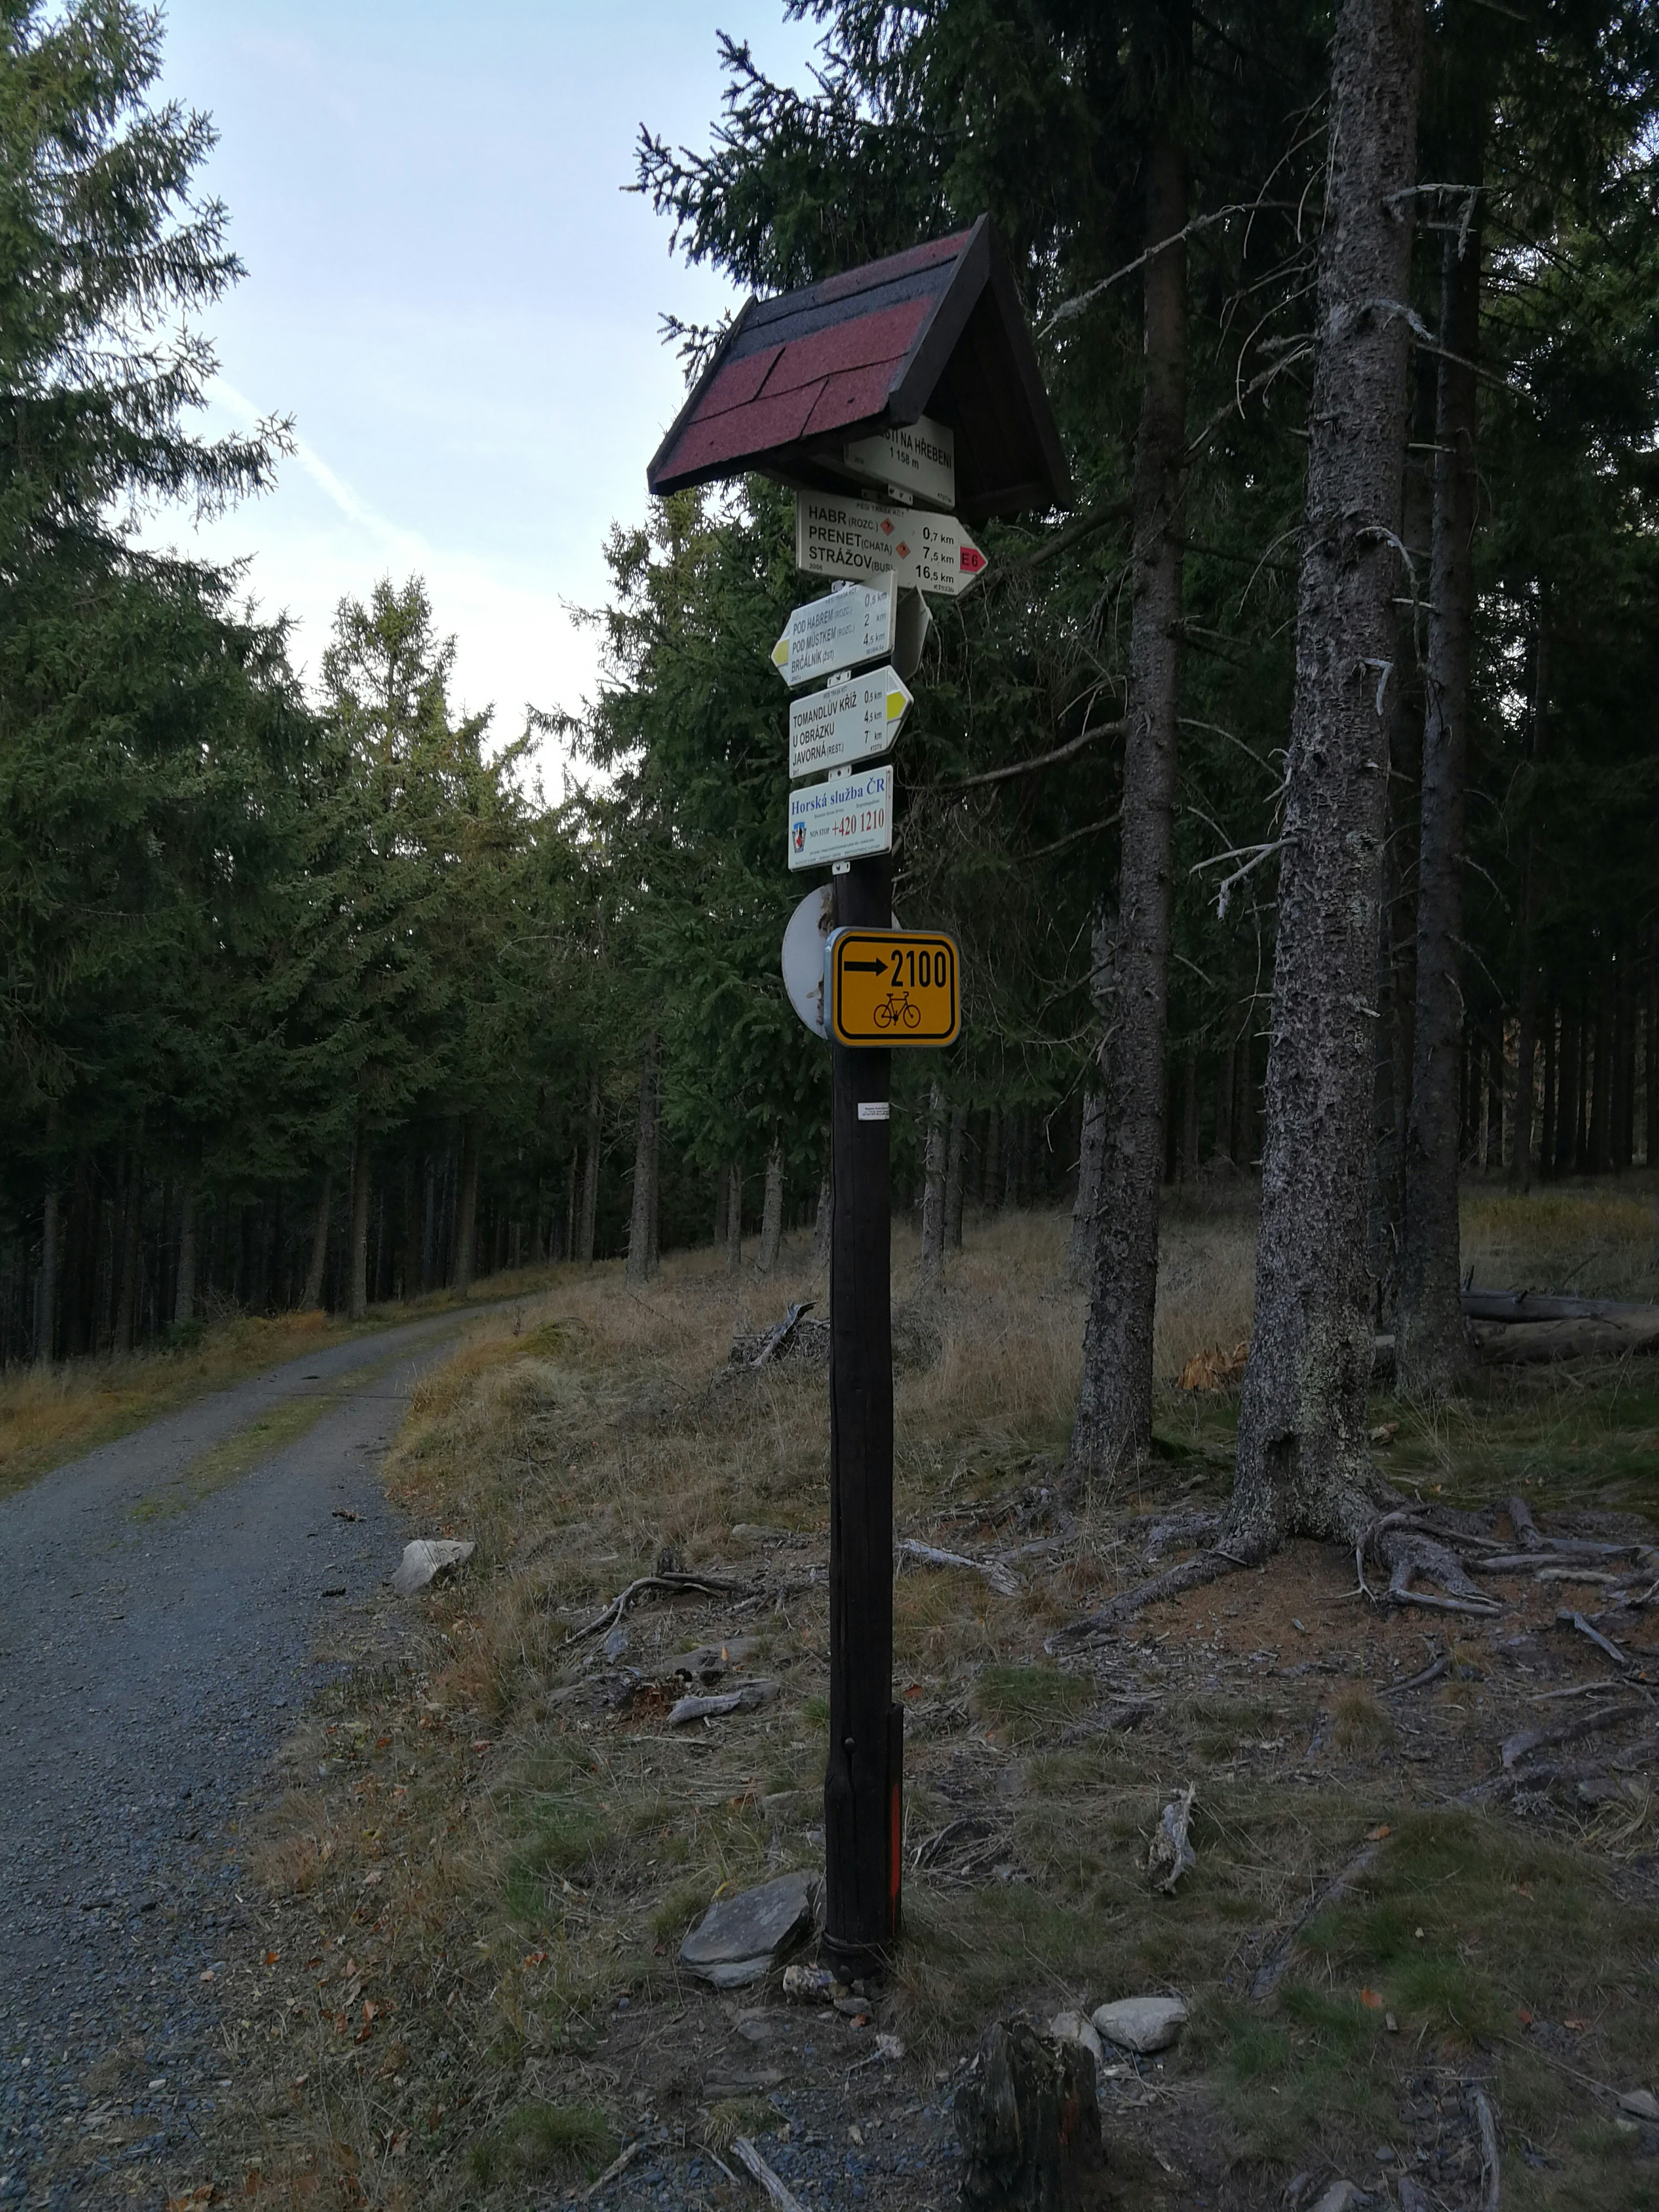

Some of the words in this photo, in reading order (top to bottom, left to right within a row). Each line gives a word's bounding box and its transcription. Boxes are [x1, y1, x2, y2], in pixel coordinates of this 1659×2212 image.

[901, 431, 913, 451] NA
[915, 438, 951, 469] HŘEBENI
[912, 458, 919, 470] m
[809, 505, 846, 524] HABR
[923, 527, 938, 543] 0,7
[941, 534, 954, 545] km
[915, 565, 938, 581] 16,5
[941, 573, 954, 583] km
[923, 546, 938, 562] 7,5
[941, 553, 954, 564] km
[793, 620, 807, 636] POD
[807, 608, 833, 629] HABREM
[864, 594, 876, 607] 0,5
[877, 591, 887, 601] km
[792, 640, 805, 655] POD
[806, 626, 836, 649] MŮSTKEM
[864, 613, 870, 626] 2
[876, 613, 886, 622] km
[863, 633, 874, 646] 4,5
[875, 632, 885, 641] km
[793, 699, 838, 729] TOMANDLŮV
[839, 691, 857, 712] KŘÍŽ
[864, 690, 873, 704] 0,5
[874, 691, 882, 700] km
[793, 736, 798, 748] U
[800, 721, 835, 746] OBRÁZKU
[864, 710, 873, 724] 4,5
[874, 711, 882, 721] km
[864, 730, 869, 744] 7
[874, 732, 882, 741] km
[791, 793, 827, 816] Horská
[830, 786, 863, 805] služba
[866, 776, 885, 795] ČR
[832, 814, 857, 836] +420
[860, 807, 884, 832] 1210
[891, 949, 946, 988] 2100
